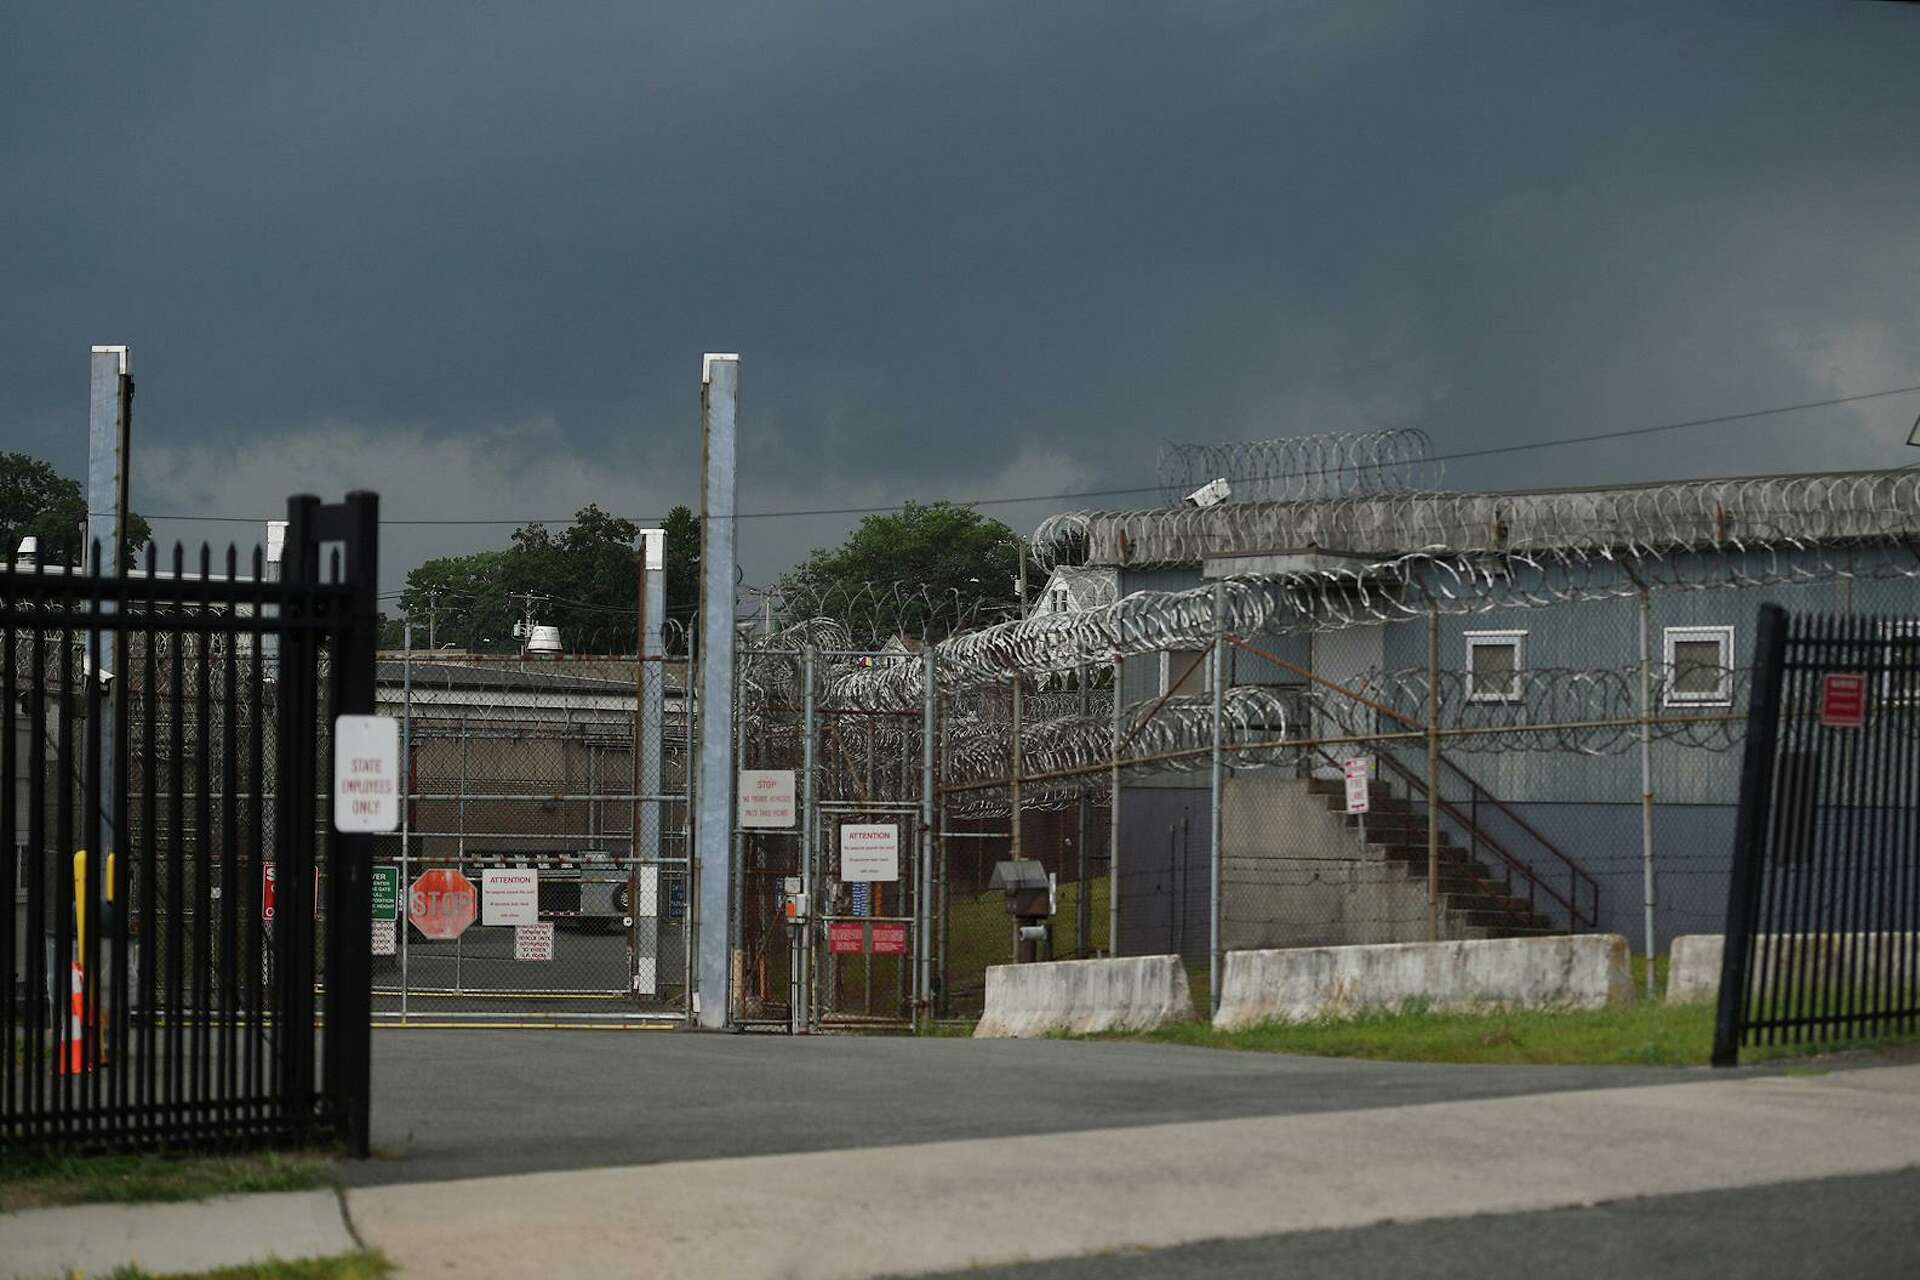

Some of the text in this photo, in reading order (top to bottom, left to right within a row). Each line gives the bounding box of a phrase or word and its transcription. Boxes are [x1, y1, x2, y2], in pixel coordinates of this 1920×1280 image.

[352, 758, 383, 774] STATE
[341, 779, 392, 794] EMPLOYEES
[757, 780, 777, 789] STOP
[352, 799, 380, 815] ONLY
[490, 876, 530, 884] ATTENTION
[414, 891, 472, 917] STOP
